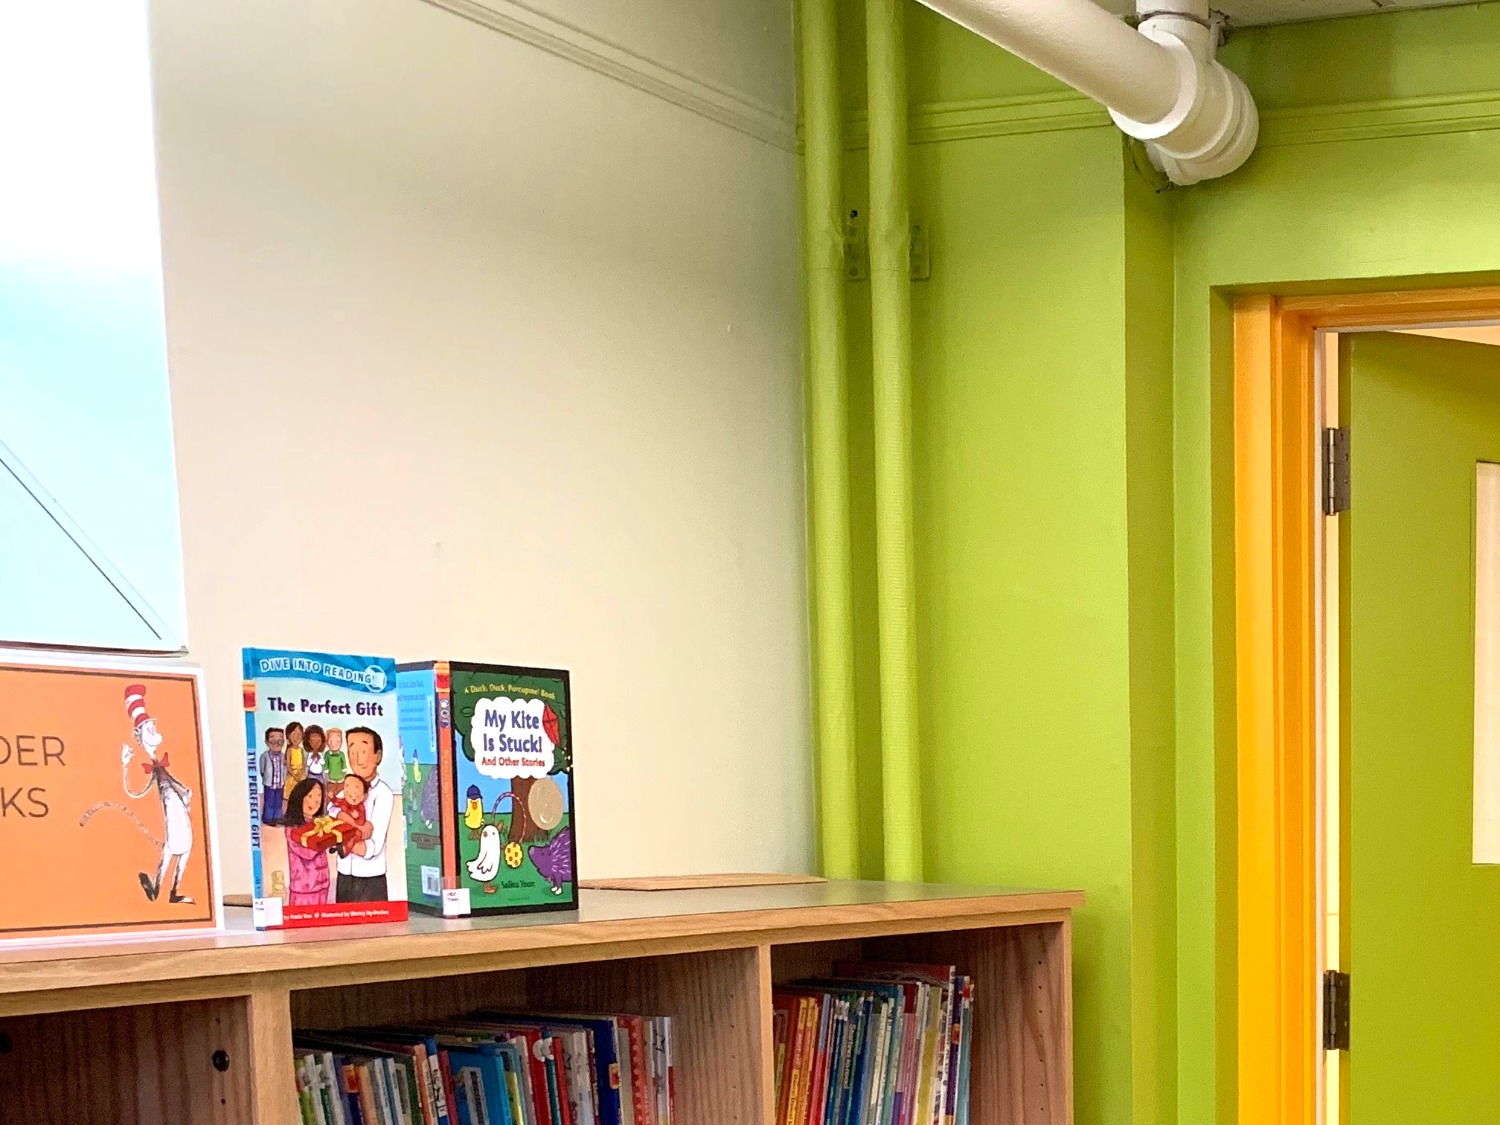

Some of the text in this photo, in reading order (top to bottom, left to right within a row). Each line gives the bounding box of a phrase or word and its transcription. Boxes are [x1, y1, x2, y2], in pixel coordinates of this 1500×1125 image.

[260, 657, 290, 673] DIVE
[293, 657, 322, 673] INTO
[267, 696, 384, 717] The Perfect Gift
[484, 709, 540, 732] My Kite
[483, 733, 542, 753] Is Stuck!
[481, 756, 546, 767] And Other Stories
[248, 775, 260, 822] PERFECT
[251, 825, 261, 849] GIFT
